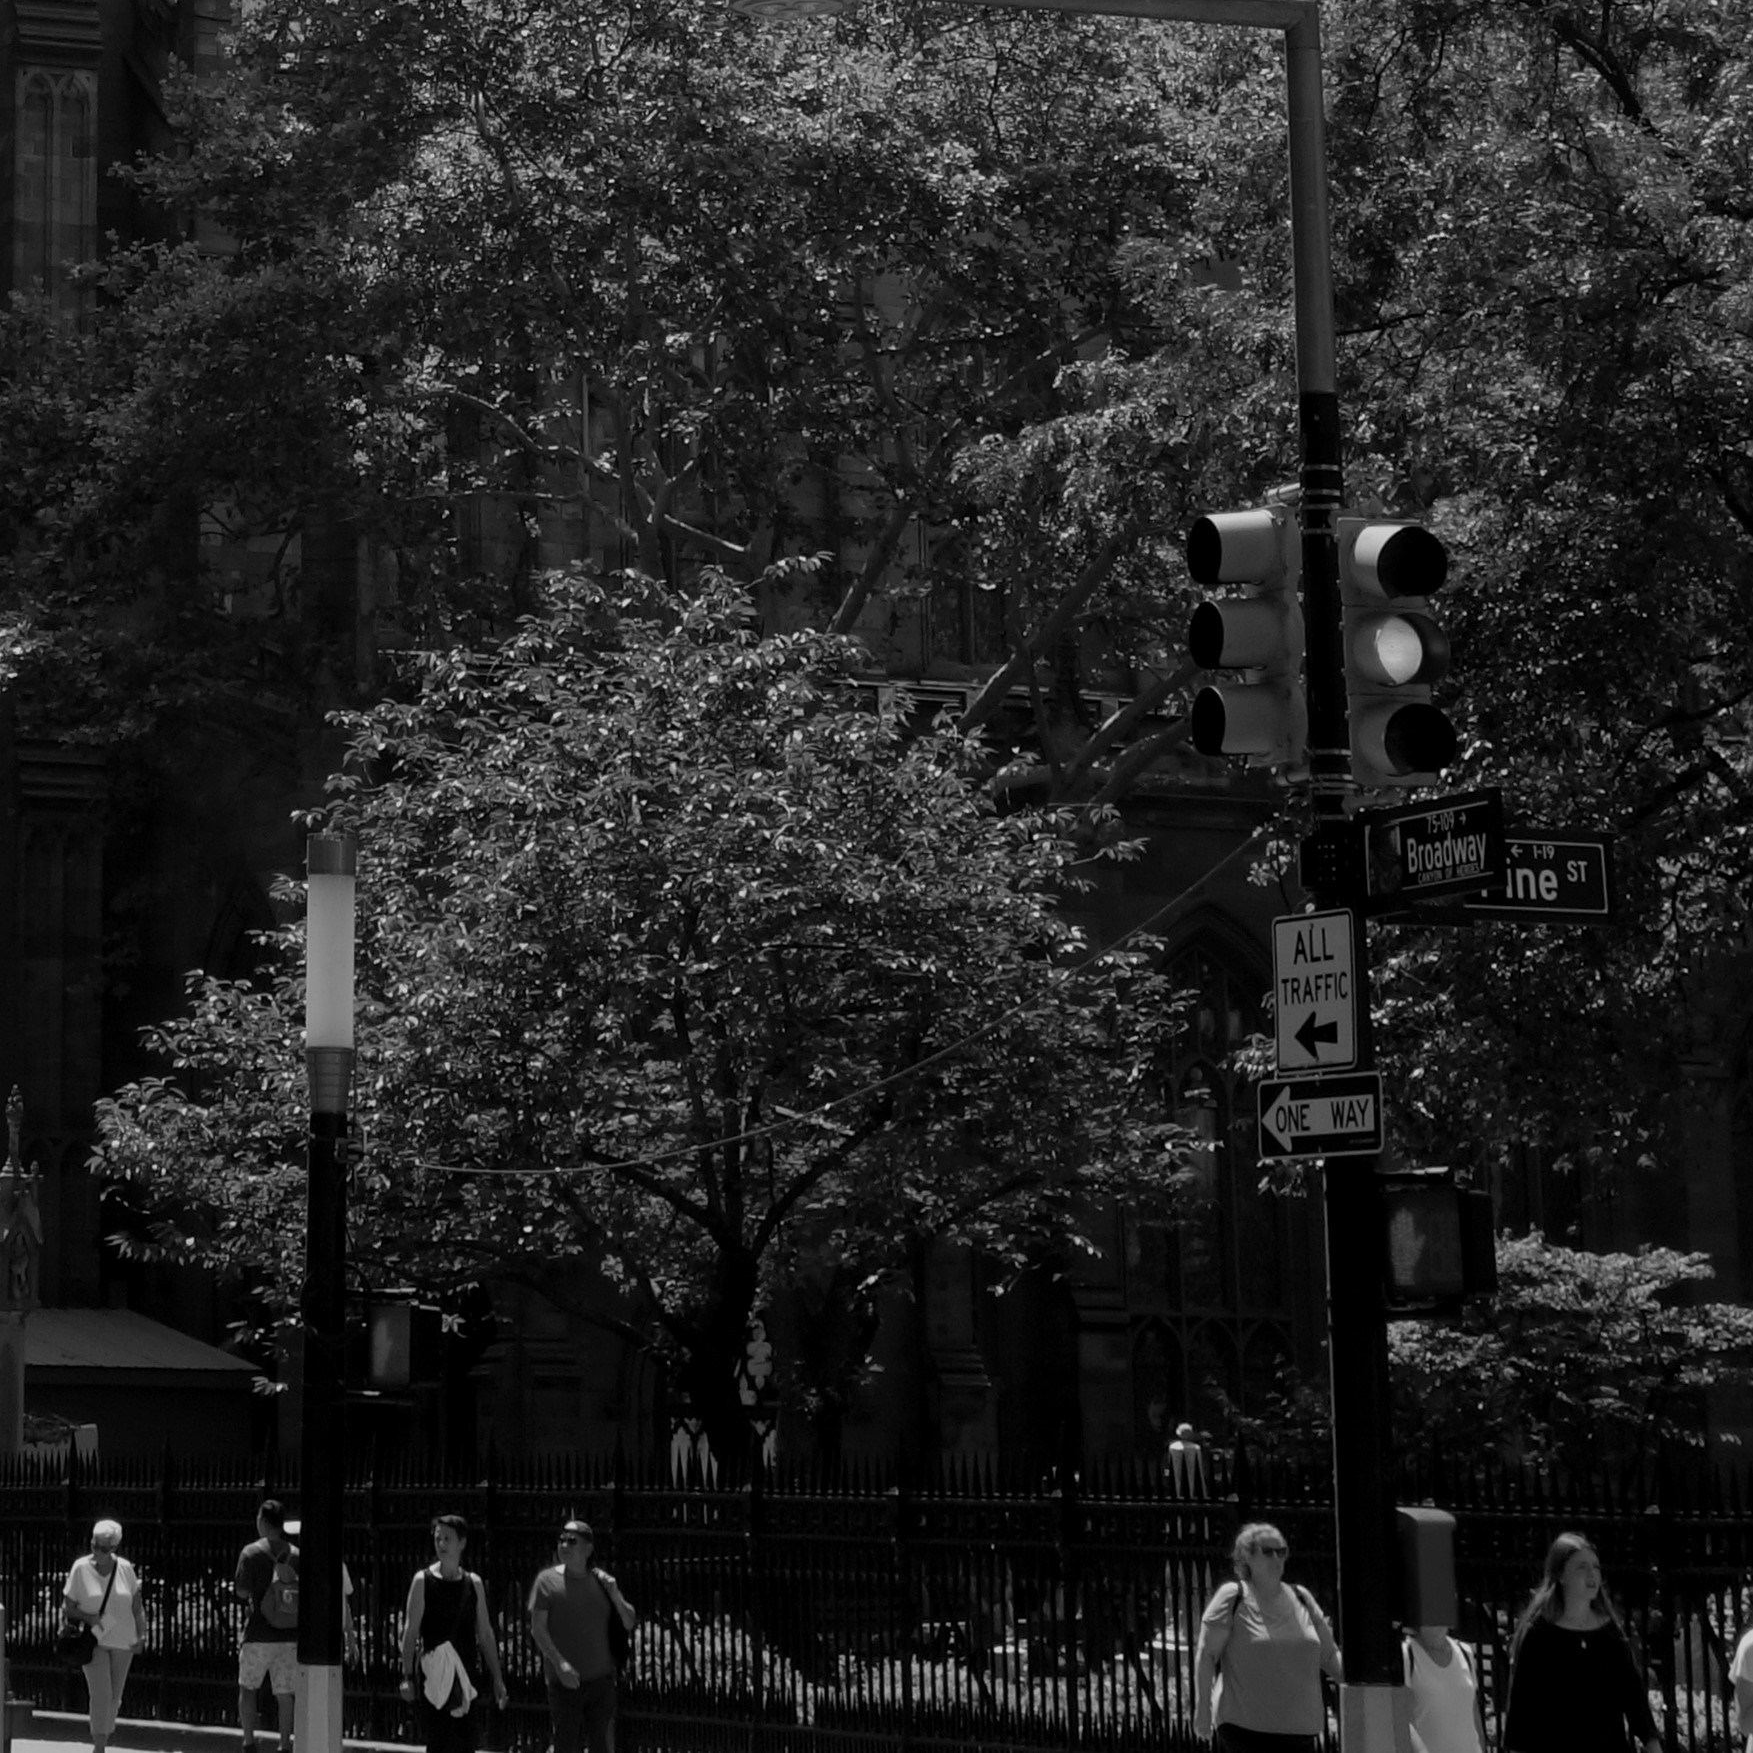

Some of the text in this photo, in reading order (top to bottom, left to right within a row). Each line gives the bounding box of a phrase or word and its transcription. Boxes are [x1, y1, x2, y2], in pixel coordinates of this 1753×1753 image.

[1406, 831, 1487, 875] Broadway
[1532, 845, 1555, 860] 1-19
[1481, 857, 1588, 902] ine ST
[1293, 925, 1334, 965] ALL
[1281, 972, 1348, 1006] TRAFFIC
[1275, 1099, 1369, 1133] ONE WAY
